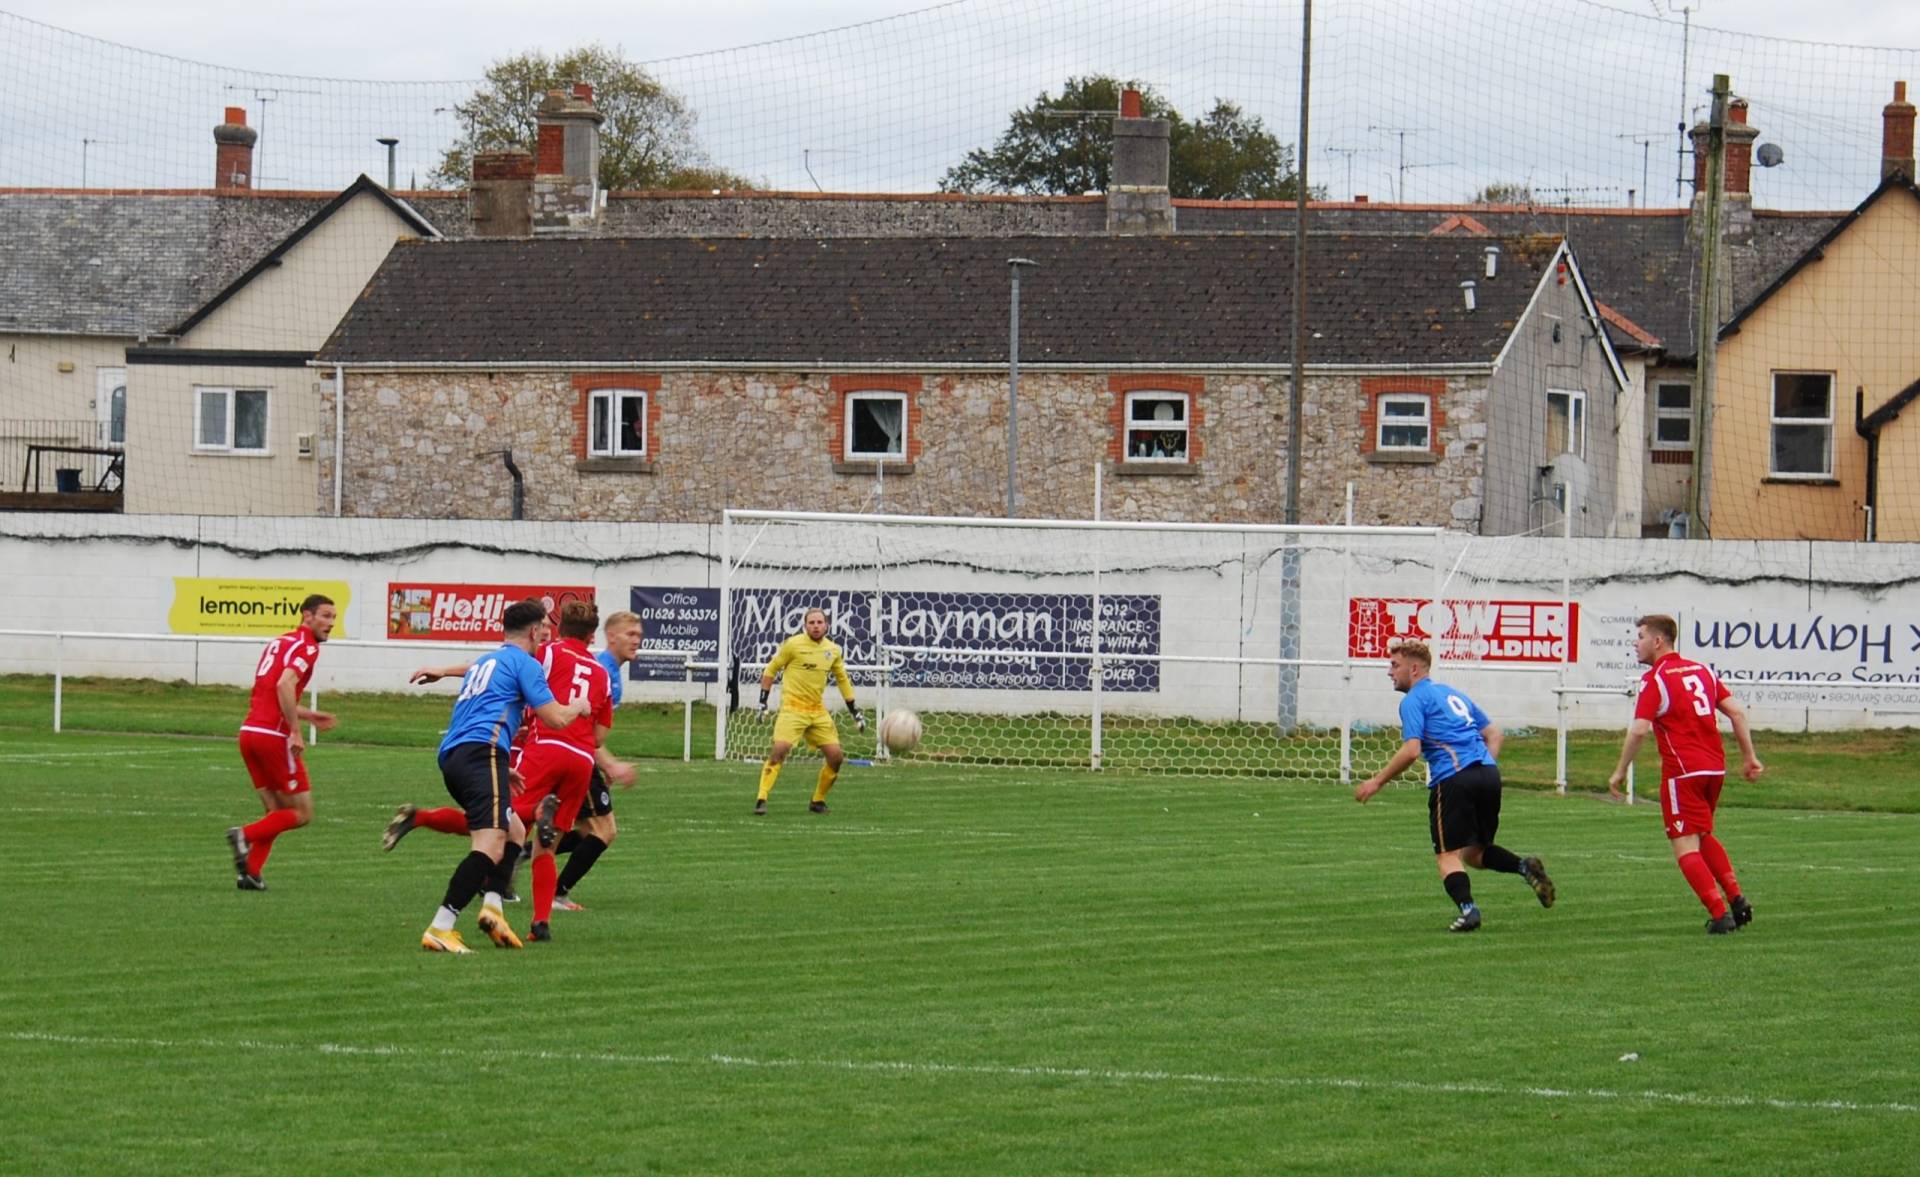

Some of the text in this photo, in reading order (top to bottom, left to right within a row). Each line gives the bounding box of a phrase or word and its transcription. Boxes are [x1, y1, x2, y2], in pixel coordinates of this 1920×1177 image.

[200, 596, 301, 616] lemon~riv
[662, 593, 698, 606] Office
[642, 608, 718, 621] 01626 363376
[744, 594, 1051, 645] Mak Hayman
[1386, 602, 1563, 637] TOWER
[432, 618, 482, 632] Electric
[659, 623, 699, 636] Mobile
[1073, 620, 1144, 632] INSRANCE
[641, 639, 718, 652] 07855 954092
[1107, 637, 1136, 649] WITH
[1138, 637, 1149, 648] A
[1590, 638, 1614, 646] HOME
[1694, 615, 1893, 663] Hayman
[1596, 661, 1623, 669] PUBLIC
[568, 663, 592, 704] 5
[988, 673, 1042, 685] Personal
[1681, 674, 1712, 716] 3
[1767, 690, 1819, 703] Reliable
[1828, 692, 1880, 704] Services
[1447, 694, 1474, 727] 9
